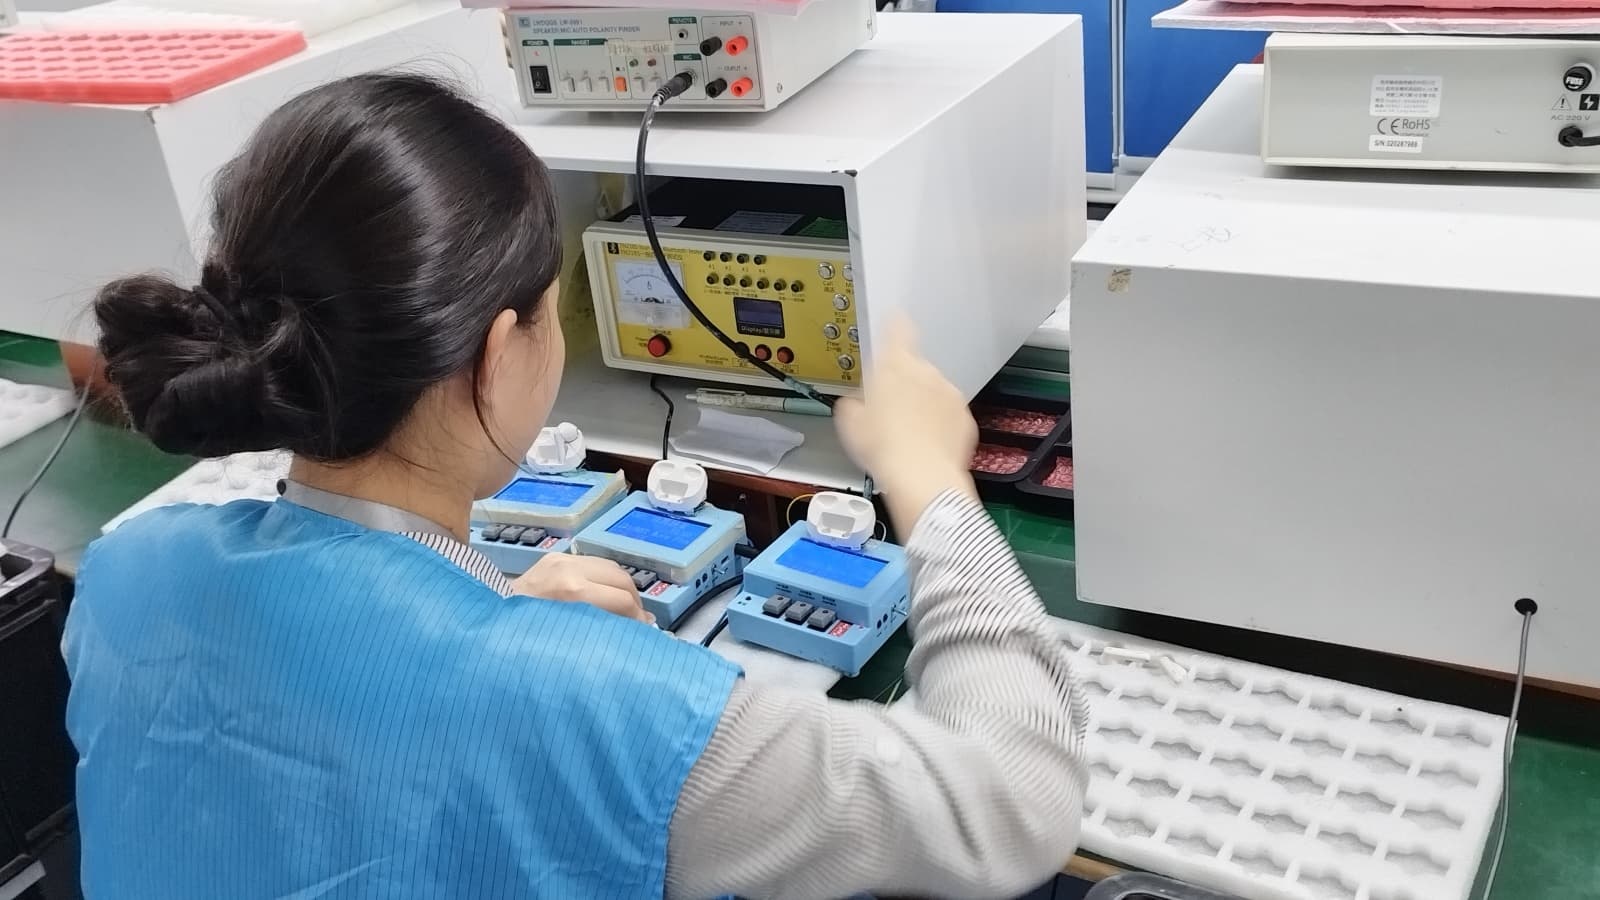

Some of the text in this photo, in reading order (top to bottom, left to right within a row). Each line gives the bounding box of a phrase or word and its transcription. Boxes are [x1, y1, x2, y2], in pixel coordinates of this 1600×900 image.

[618, 25, 640, 33] FINDER
[1566, 76, 1585, 86] FUSE
[1402, 118, 1431, 130] RoHS
